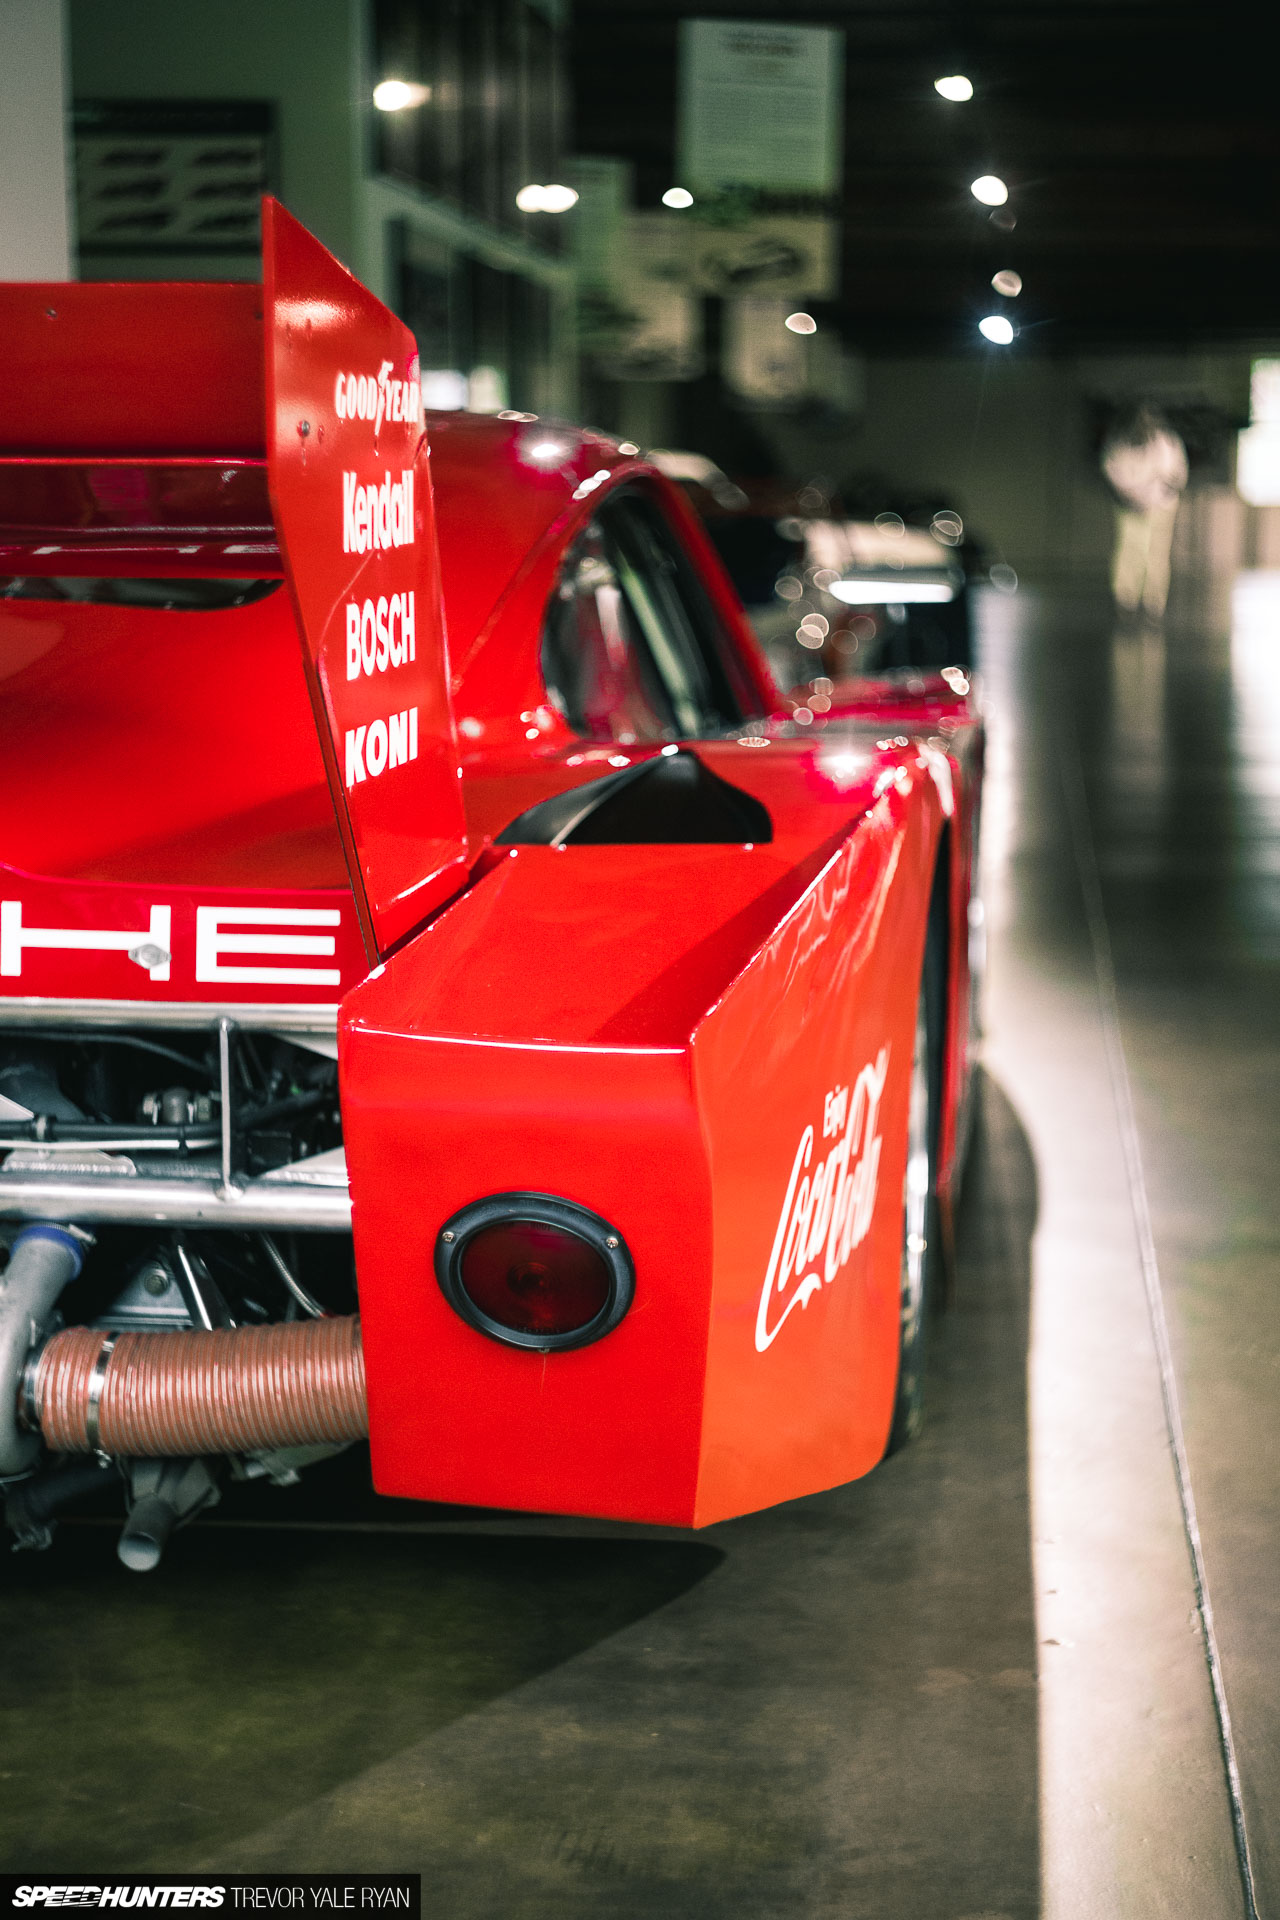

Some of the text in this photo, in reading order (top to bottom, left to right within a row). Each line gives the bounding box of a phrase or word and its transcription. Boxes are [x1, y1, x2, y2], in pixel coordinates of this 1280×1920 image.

[335, 369, 419, 423] GOODYEAR
[343, 469, 414, 554] Kendall
[346, 591, 415, 681] BOSCH
[345, 707, 417, 788] KONI
